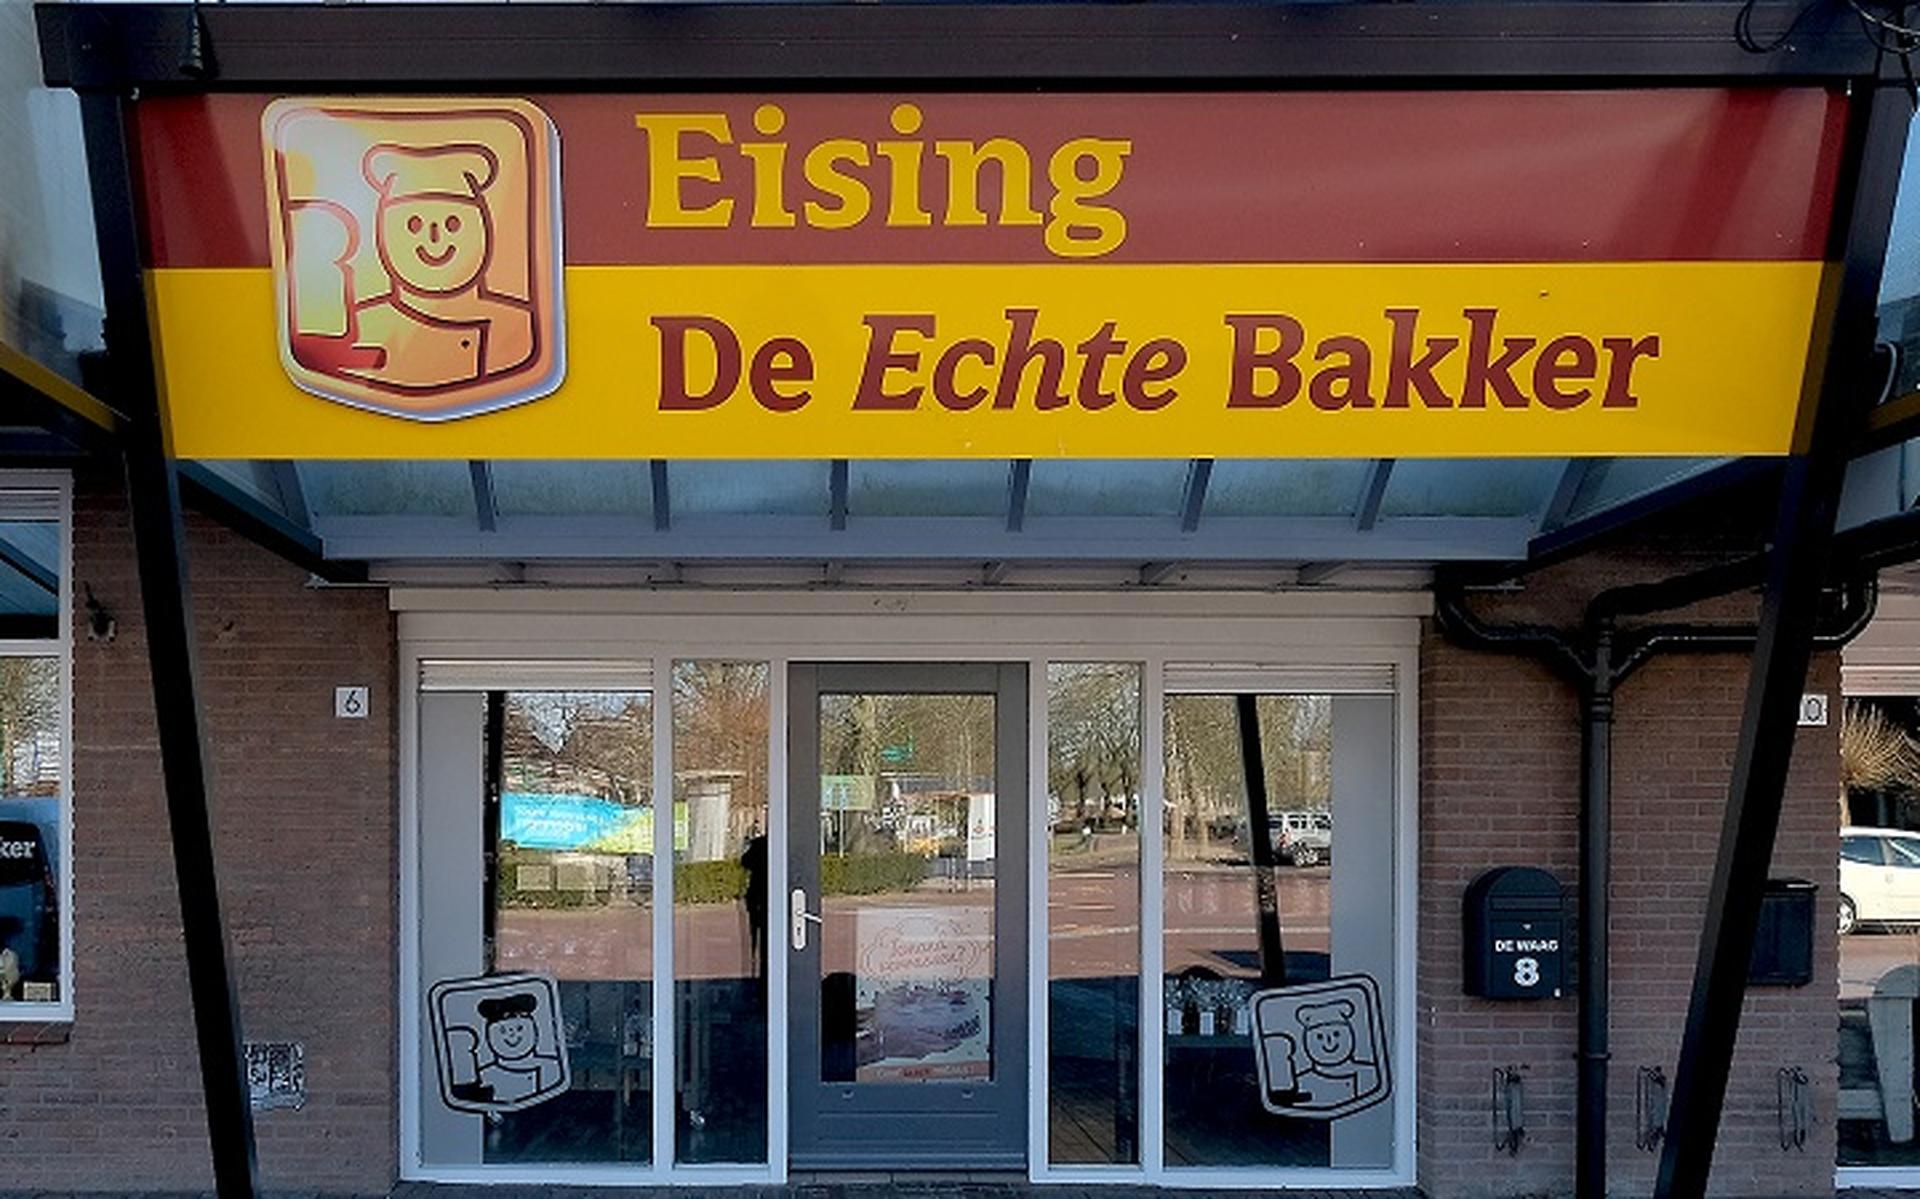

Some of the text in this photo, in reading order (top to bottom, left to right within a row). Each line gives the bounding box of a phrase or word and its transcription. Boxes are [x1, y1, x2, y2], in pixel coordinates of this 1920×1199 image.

[635, 103, 1132, 258] Eising
[650, 308, 1660, 412] De Echte Bakker
[345, 690, 361, 714] 6
[1495, 939, 1559, 952] DE WAAG
[1514, 956, 1540, 987] 8
